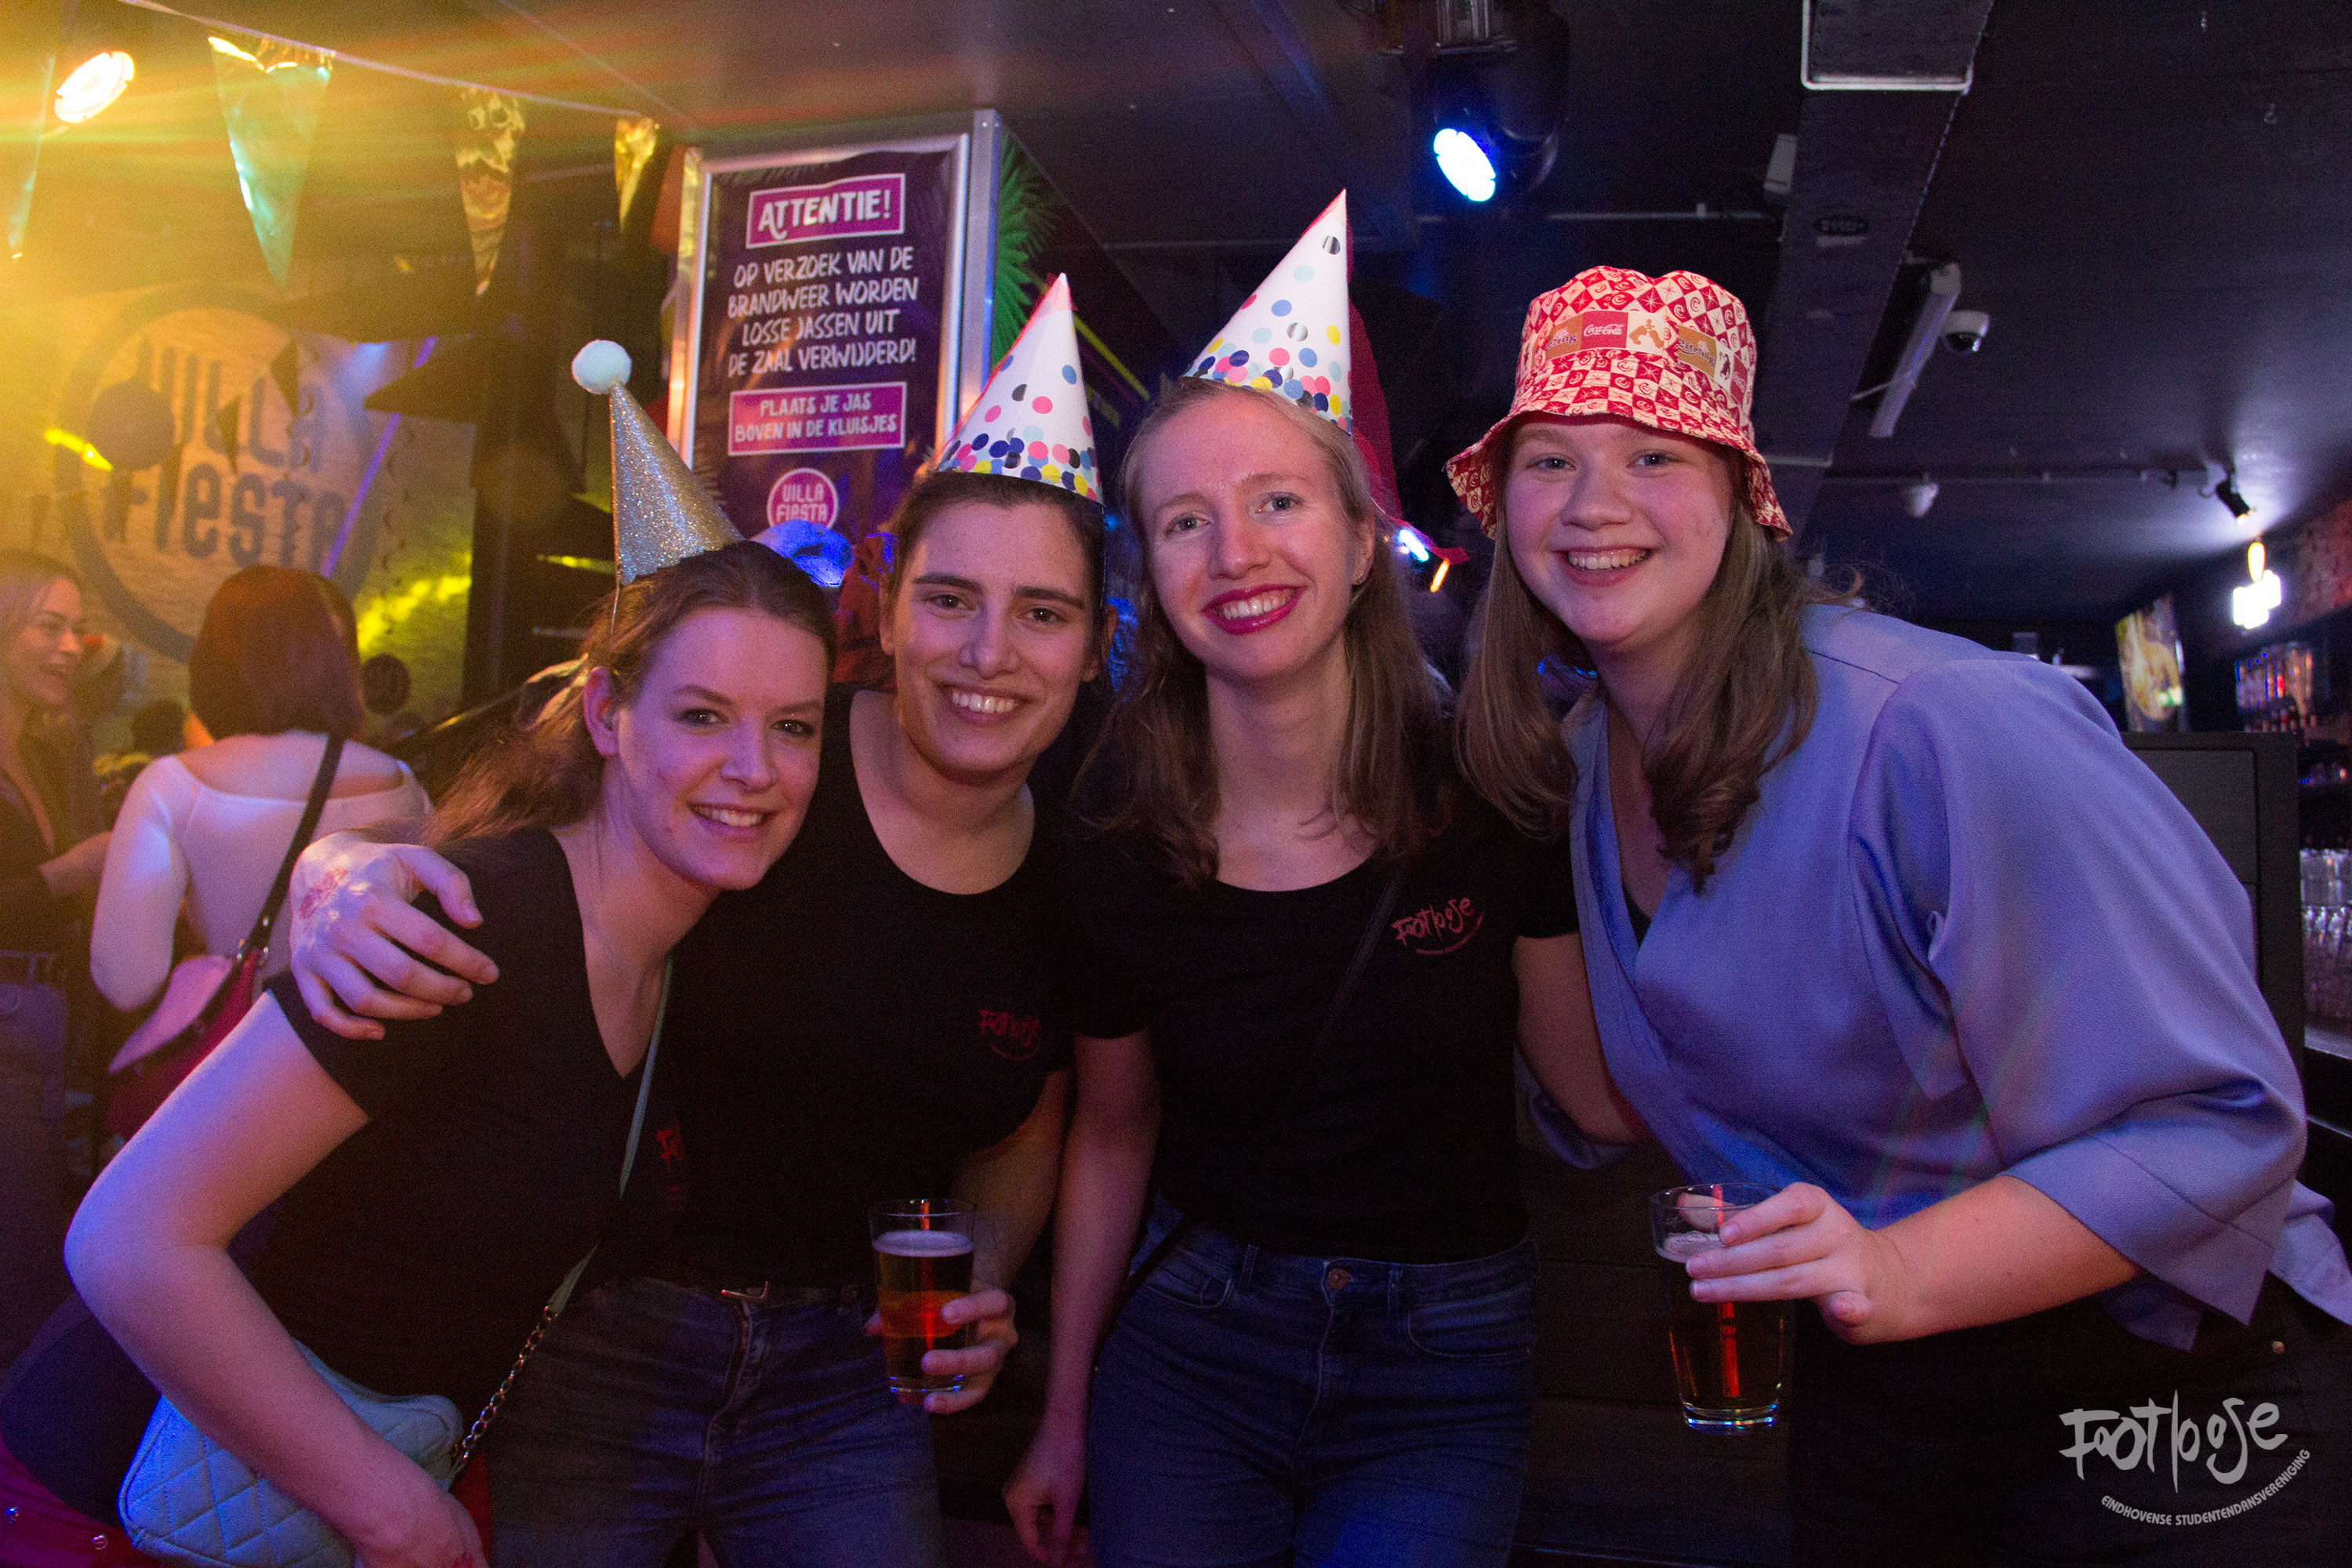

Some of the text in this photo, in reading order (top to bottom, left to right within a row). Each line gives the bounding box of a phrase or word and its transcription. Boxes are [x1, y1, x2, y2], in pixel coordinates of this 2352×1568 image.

[758, 190, 891, 240] ATTENTIE!
[733, 246, 914, 289] OP VERZOEK VAN DE
[728, 277, 919, 319] BRANDWEER WORDEN
[742, 308, 901, 347] LOSSE JASSEN UIT
[1584, 323, 1624, 337] Coca-Cola
[728, 338, 916, 378] DE ZAAL VERWIJDERD!
[760, 392, 872, 417] PLAATS JE JAS
[735, 413, 897, 443] BOVEN IN DE KLUISJES
